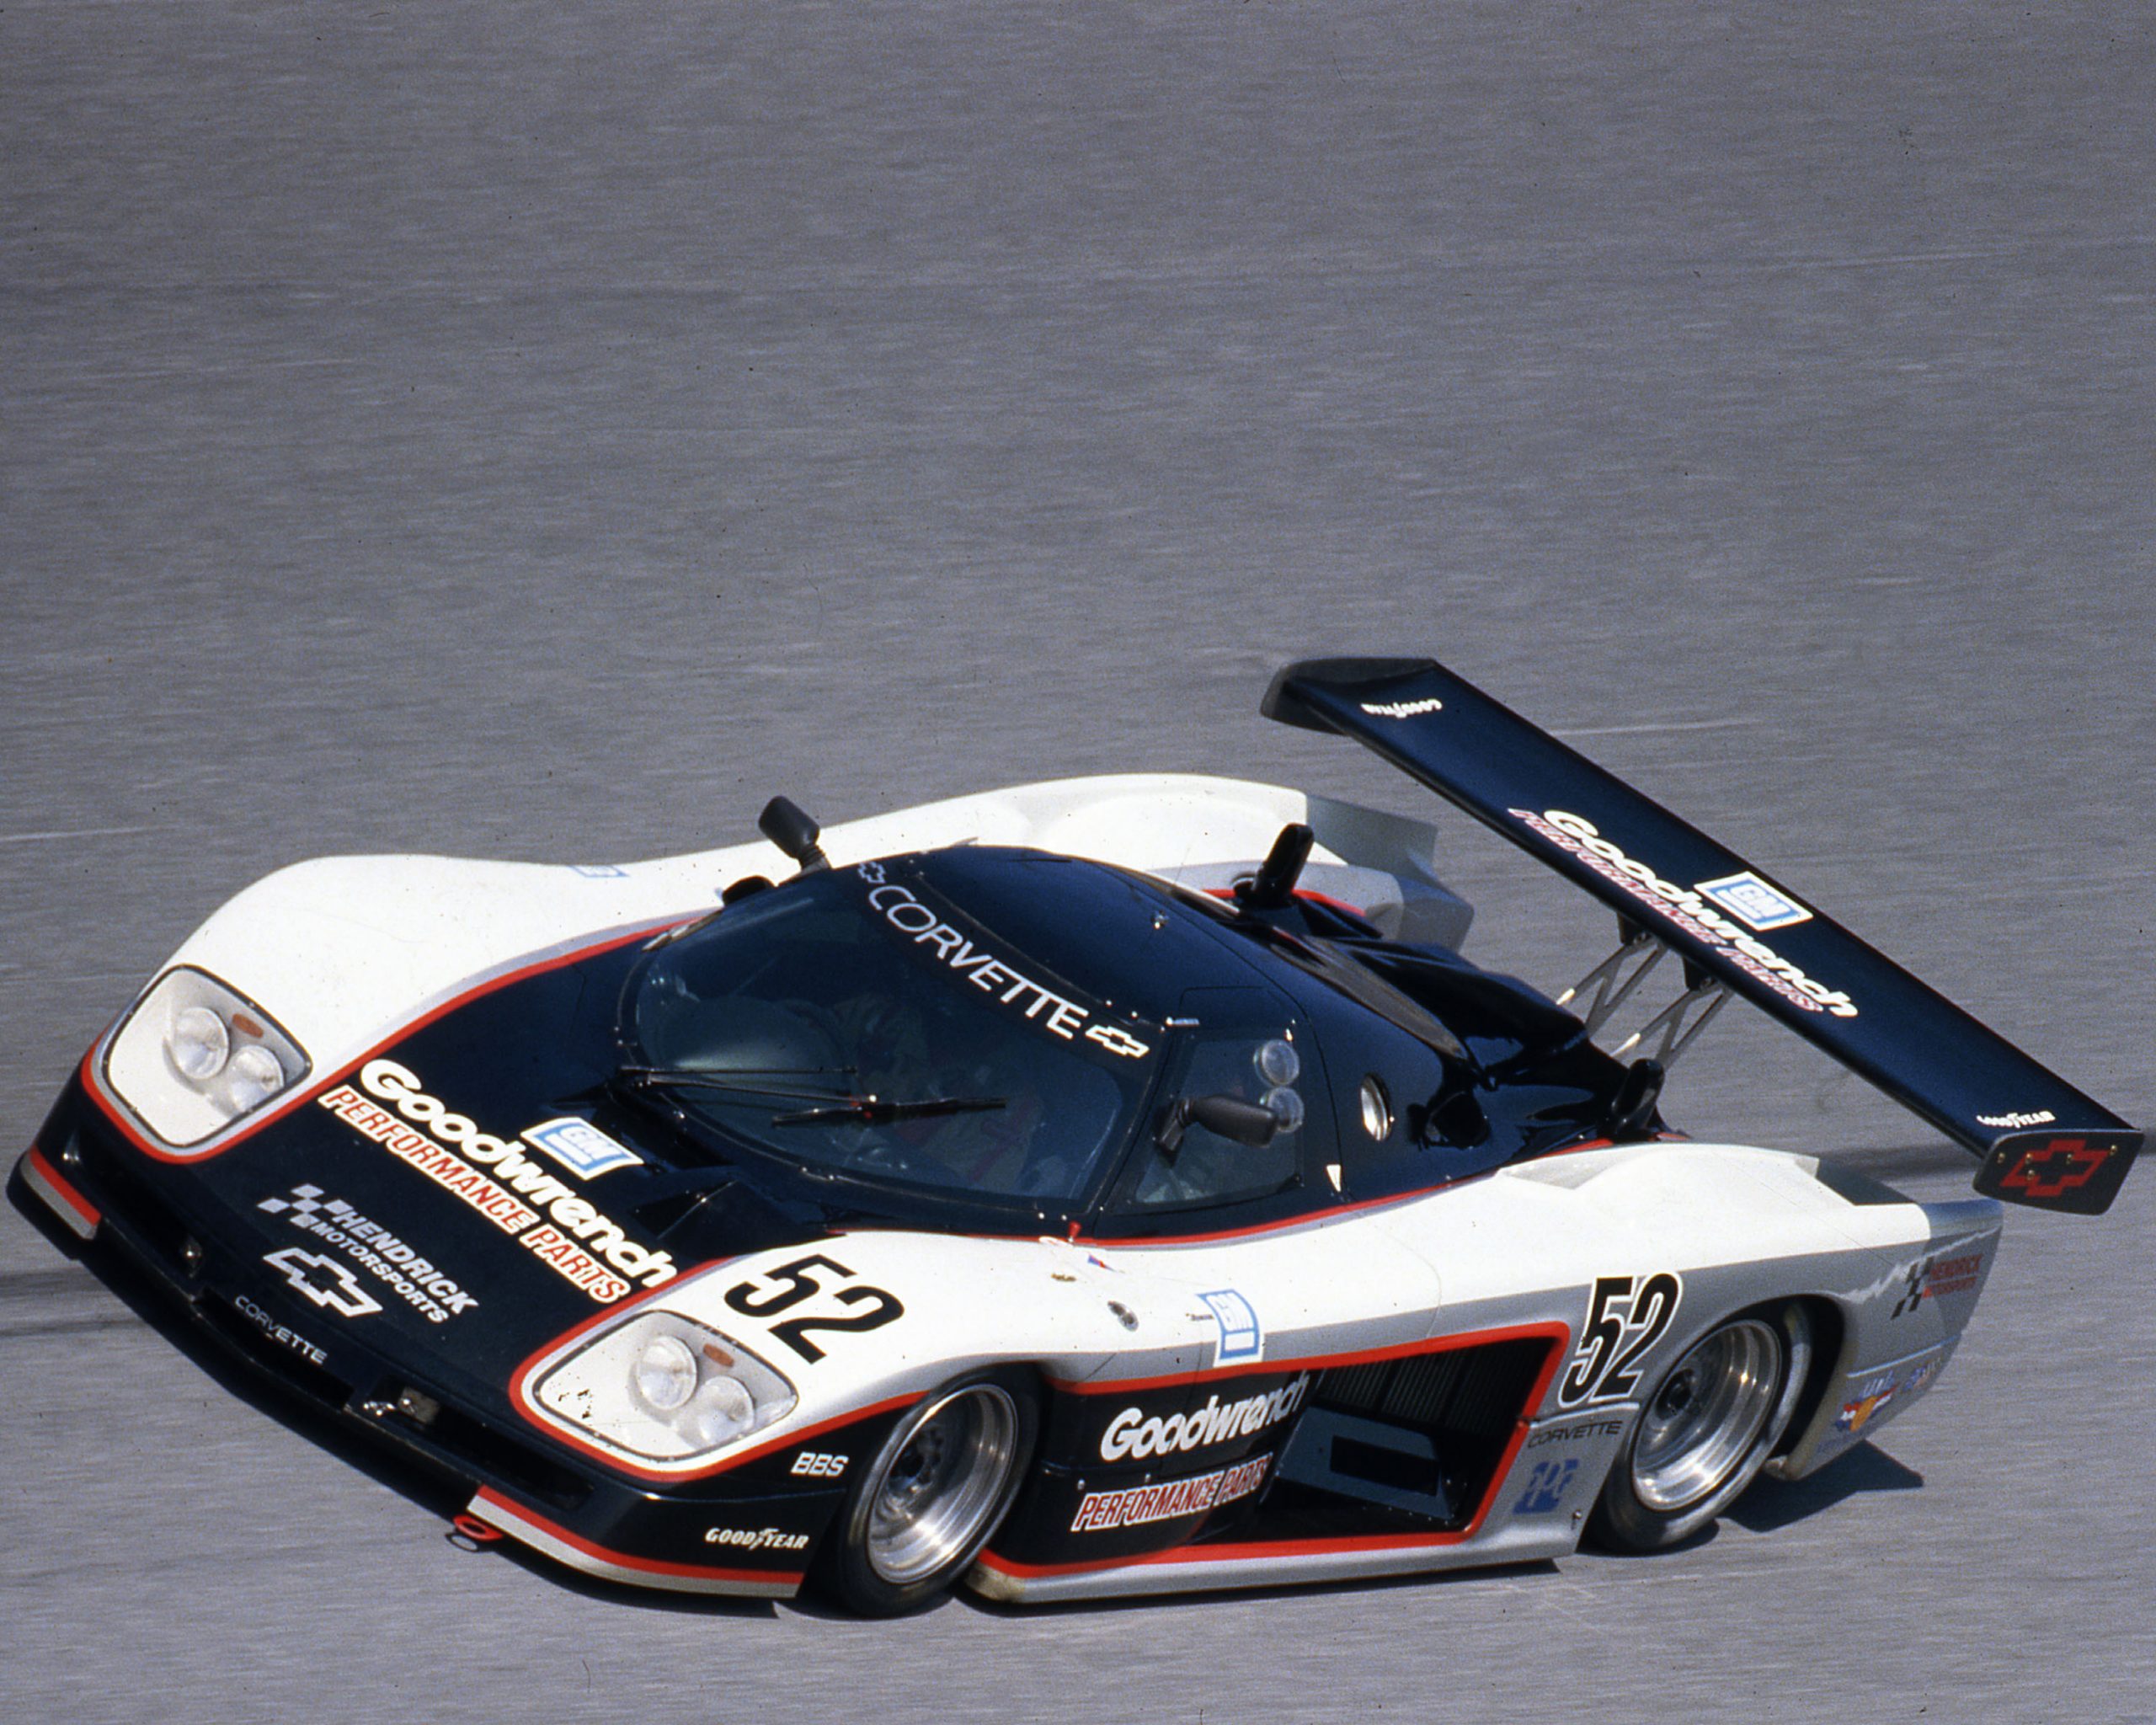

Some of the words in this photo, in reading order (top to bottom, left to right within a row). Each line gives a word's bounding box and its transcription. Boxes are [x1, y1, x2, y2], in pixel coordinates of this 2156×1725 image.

[868, 885, 1089, 1039] CORVETTE
[1543, 809, 1859, 1017] Goodwrench
[318, 1085, 541, 1236] PERFORMANCE
[519, 1223, 632, 1304] PARTS
[360, 1059, 678, 1288] Goodwrench
[310, 1221, 450, 1324] MOTORSPORTS
[331, 1210, 479, 1315] HENDRICK
[723, 1253, 905, 1365] 52
[235, 1294, 328, 1365] CORVETTE
[1558, 1271, 1683, 1408] 52
[790, 1451, 850, 1477] BBS
[1100, 1371, 1310, 1461] Goodwrench
[1528, 1420, 1624, 1448] CORVETTE
[705, 1527, 809, 1551] GOODYEAR
[1070, 1470, 1225, 1532] PERFORMANCE
